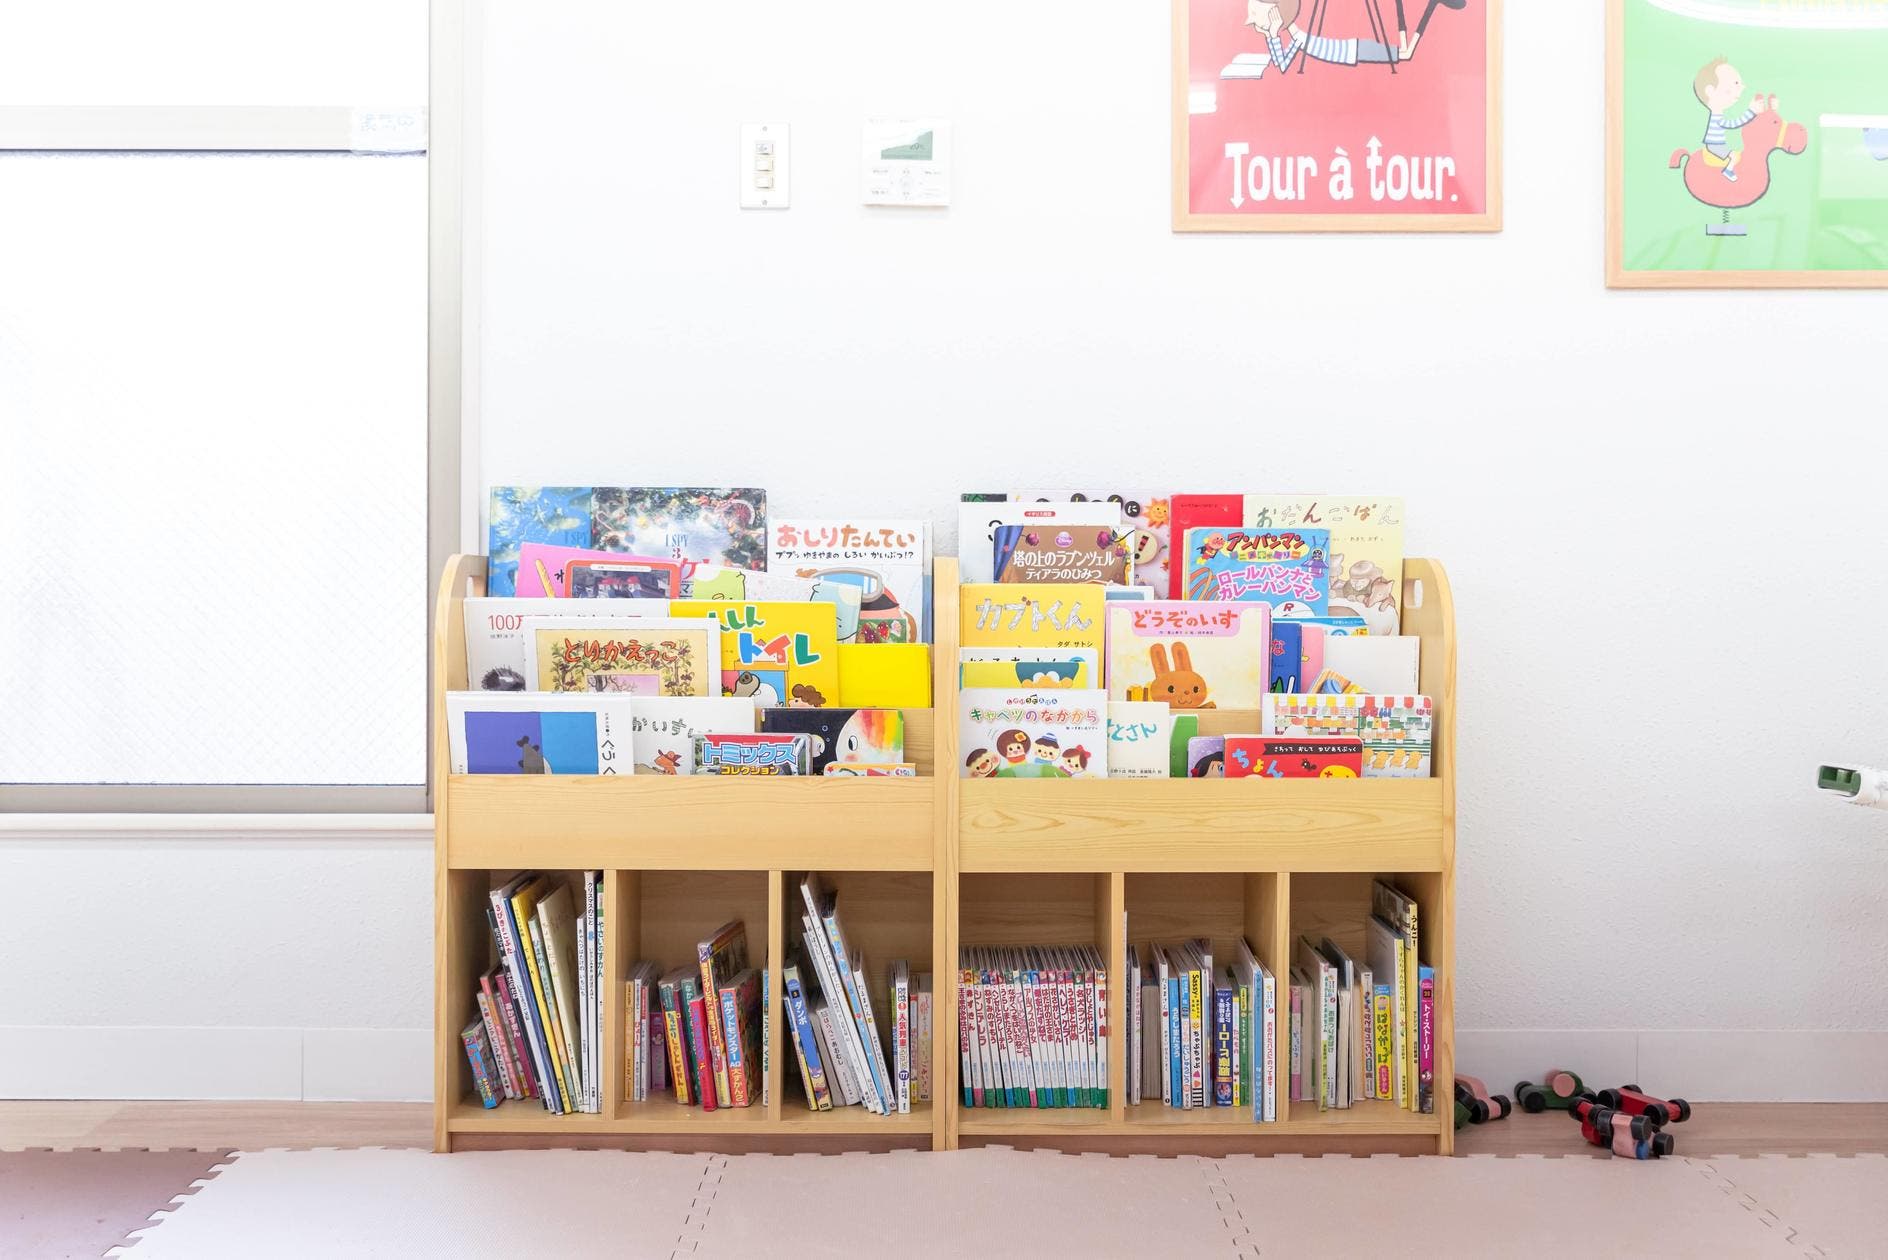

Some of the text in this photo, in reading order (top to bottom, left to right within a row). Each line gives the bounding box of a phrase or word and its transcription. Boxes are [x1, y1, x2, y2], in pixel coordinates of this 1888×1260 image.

[1225, 135, 1458, 209] Tour à tour.
[671, 534, 688, 547] SPY
[777, 524, 916, 548] おしりたんてい
[1227, 532, 1306, 552] アンパンマン
[672, 548, 682, 560] 3
[803, 551, 840, 559] ゆきやまの
[844, 551, 867, 559] しろい
[1013, 551, 1116, 568] 塔の上のラプンツェル
[1025, 568, 1102, 580] ティアラのひみつ
[1217, 564, 1313, 586] ロールパンナと
[976, 597, 1093, 632] カブトくん
[1134, 609, 1238, 629] どうぞのいす
[564, 638, 679, 663] とりかえっこ
[739, 632, 820, 665] トイレ
[970, 708, 1100, 724] キャベツのなかから
[703, 742, 798, 764] トミックス
[720, 765, 781, 776] コレクション
[1192, 974, 1200, 999] Sassy
[794, 1001, 808, 1026] ダンボ
[975, 989, 986, 1046] シンデレラ
[723, 1001, 739, 1061] ポケットモンスター
[1423, 1004, 1431, 1059] トイ・ストーリー
